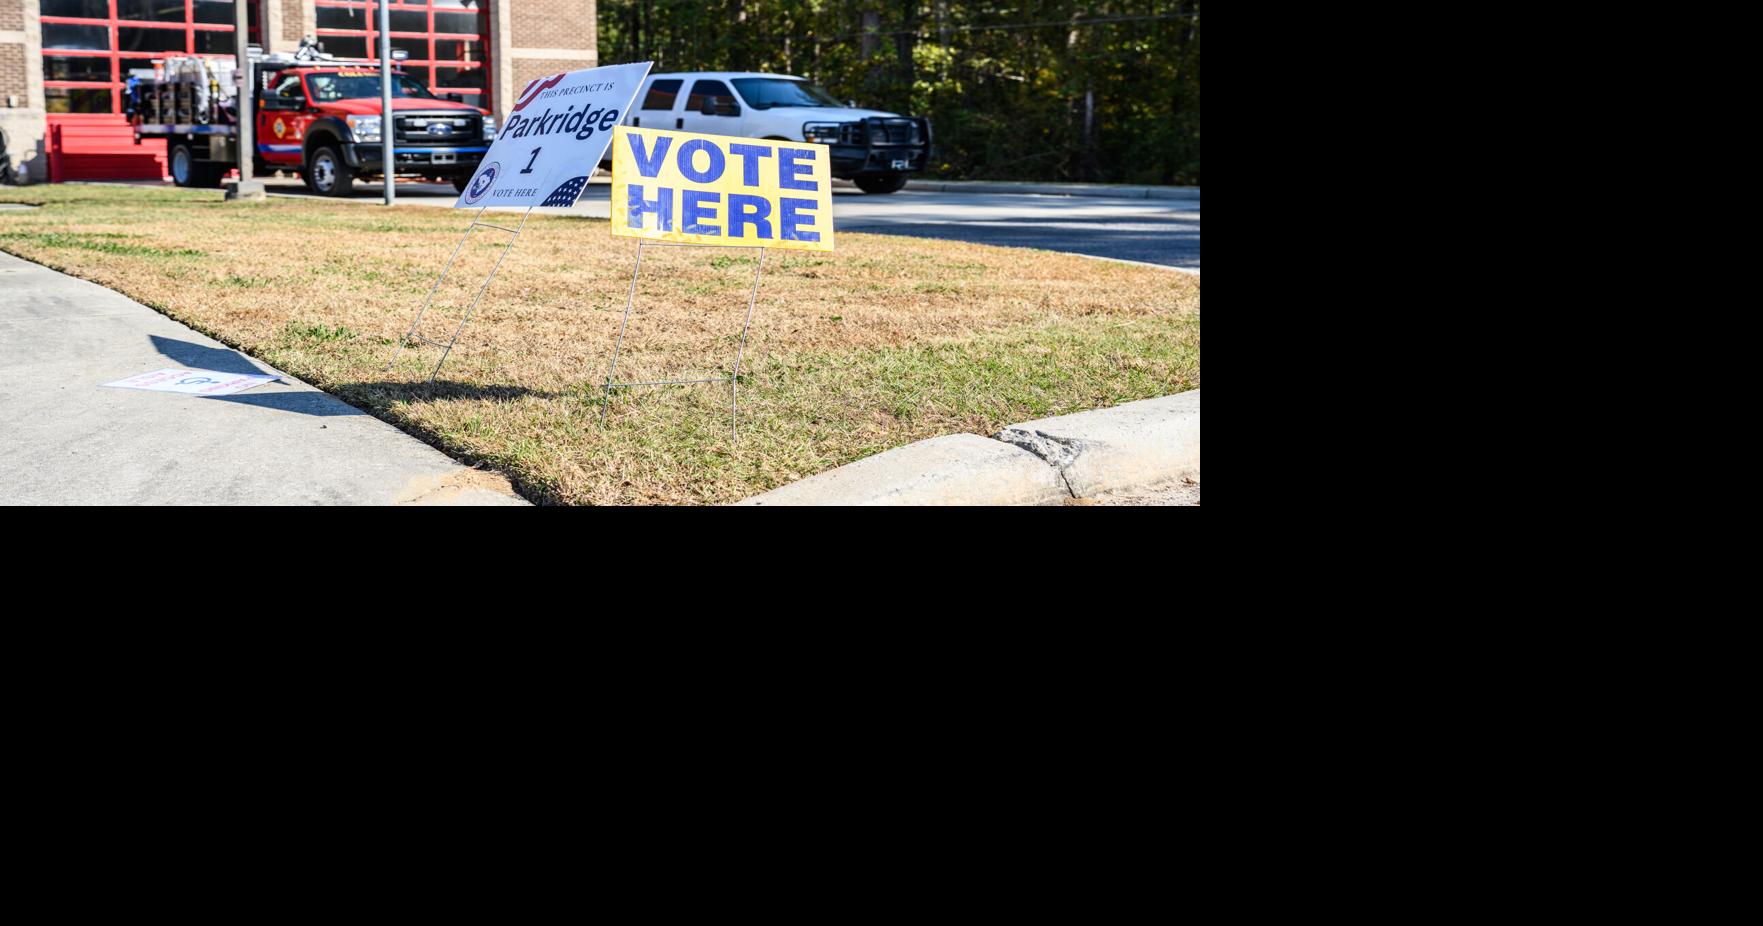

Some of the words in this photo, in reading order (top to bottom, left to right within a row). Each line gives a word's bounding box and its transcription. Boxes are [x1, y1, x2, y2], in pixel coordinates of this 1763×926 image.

[540, 90, 558, 99] THIS
[559, 84, 603, 97] PRECINCT
[602, 81, 615, 91] IS
[499, 103, 620, 141] Parkridge
[519, 146, 542, 175] 1
[626, 132, 819, 192] VOTE
[492, 188, 514, 198] VOTE
[513, 188, 538, 198] HERE
[627, 183, 821, 243] HERE
